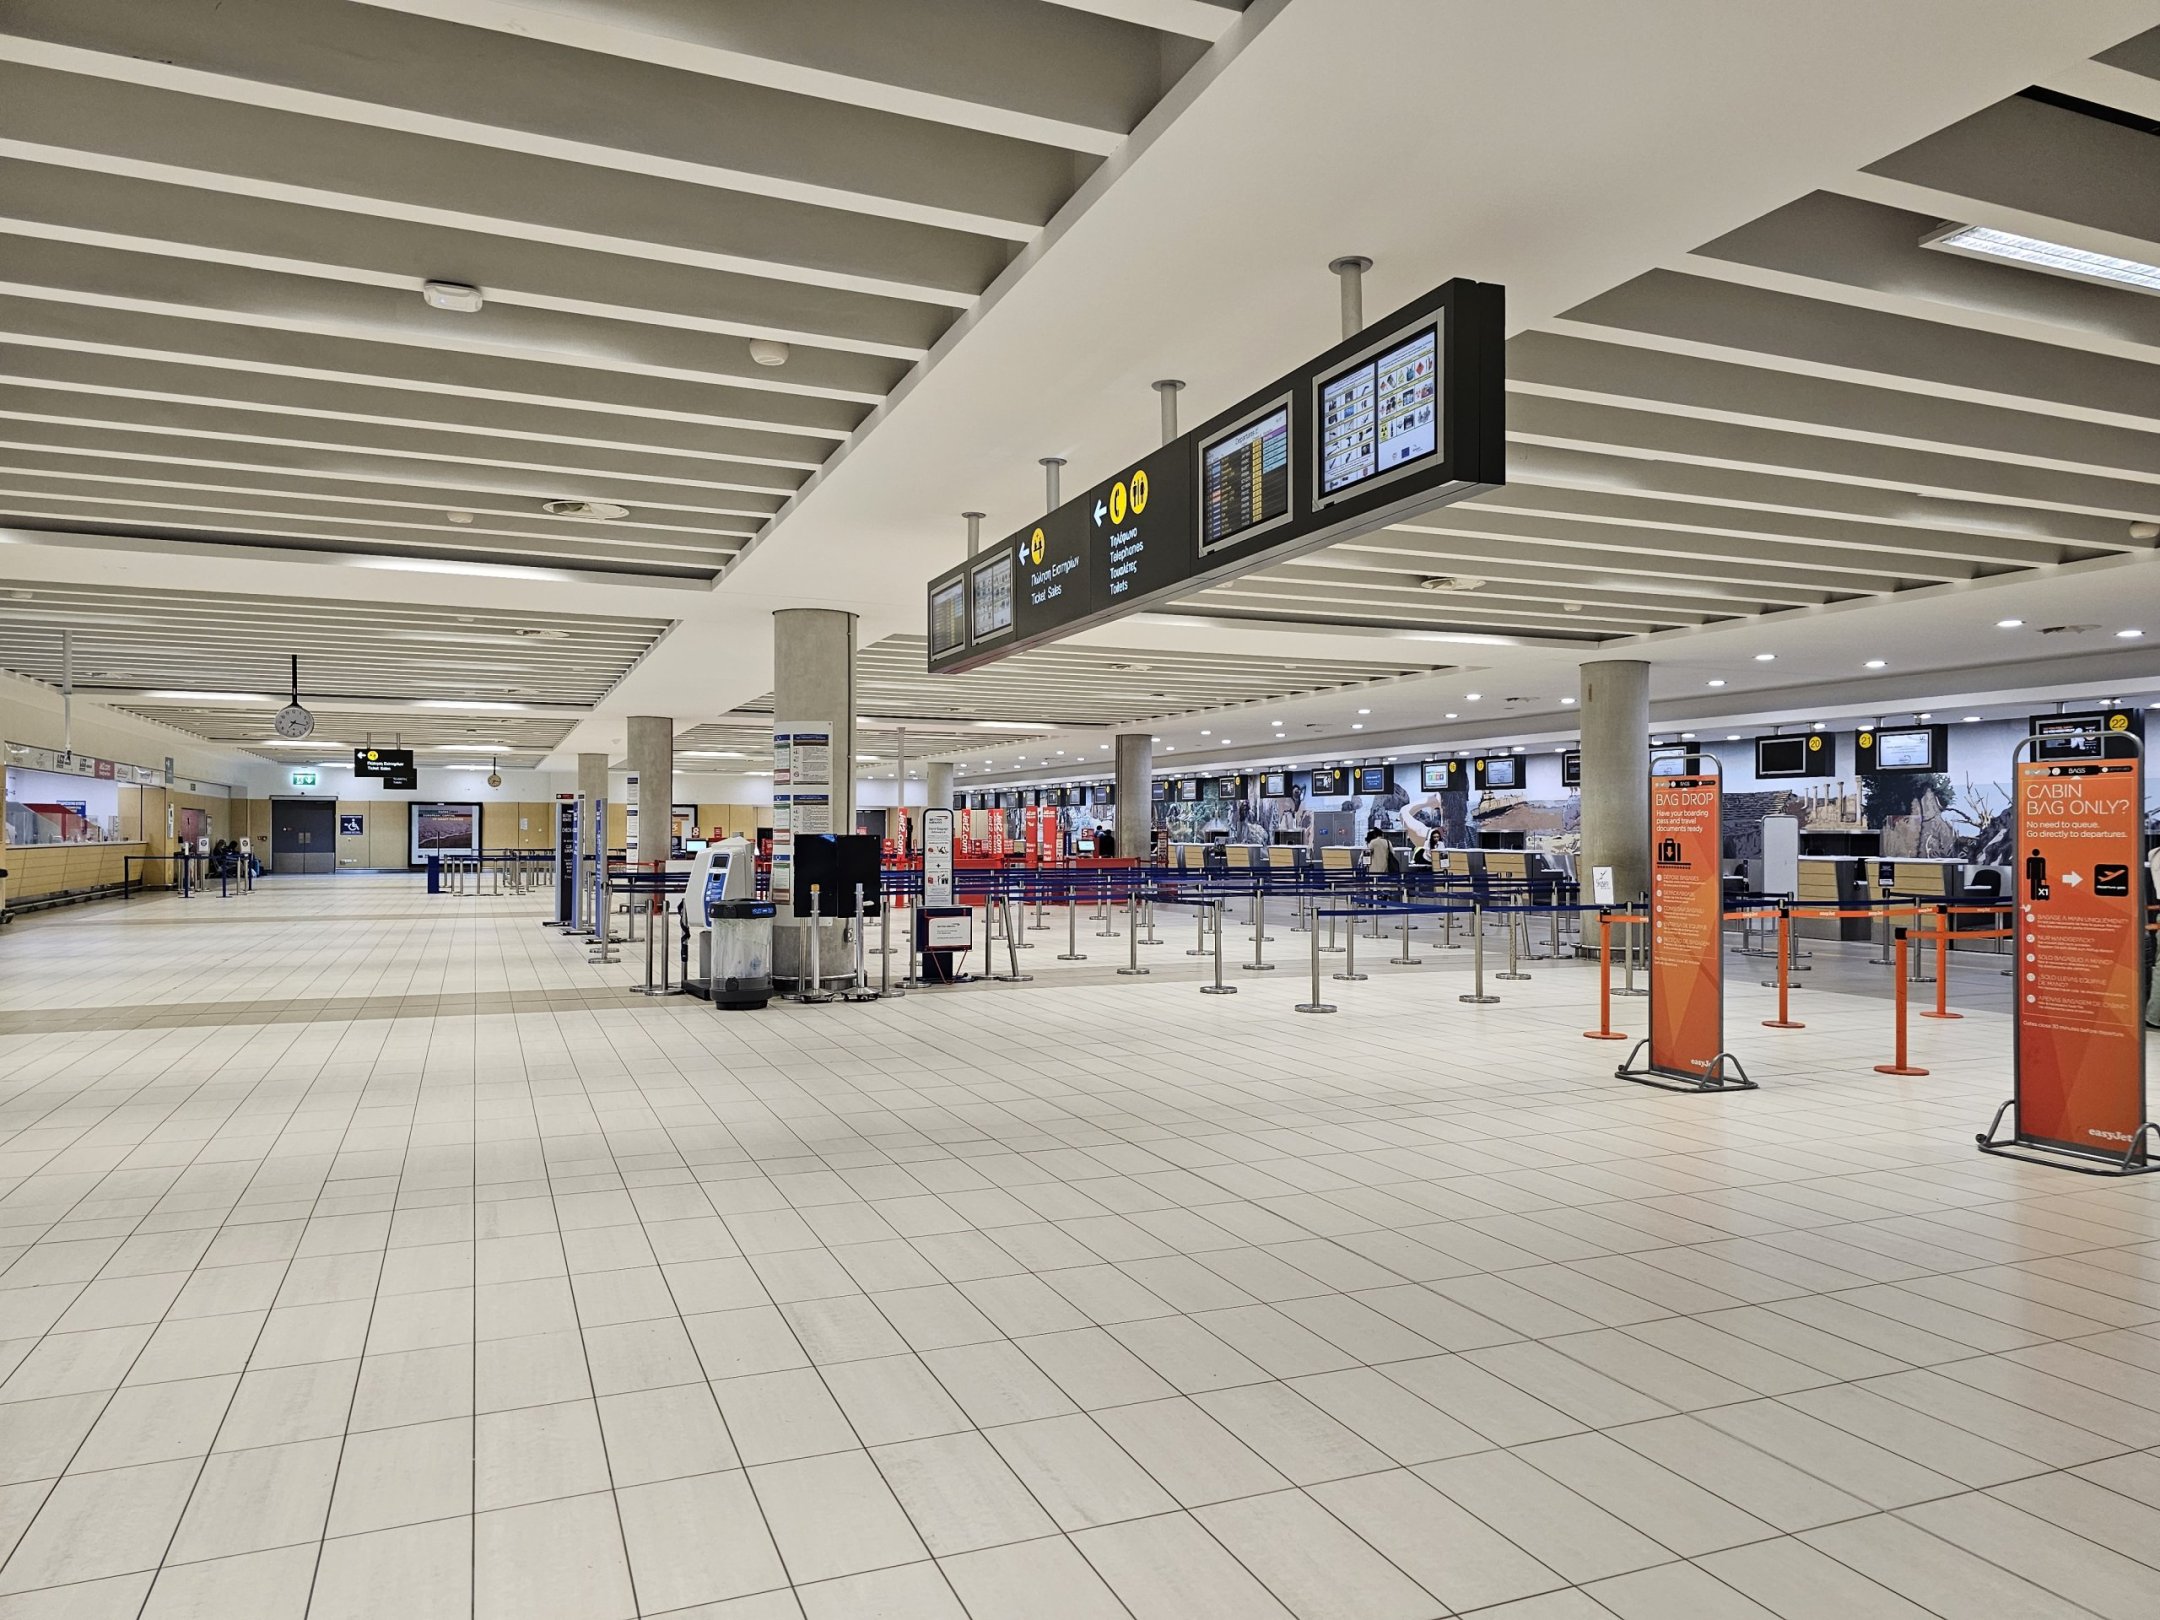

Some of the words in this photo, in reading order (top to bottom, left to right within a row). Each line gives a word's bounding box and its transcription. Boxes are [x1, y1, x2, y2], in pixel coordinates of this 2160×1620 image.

[1110, 541, 1144, 564] Telephones
[1110, 560, 1137, 580] Τουαλέτες
[1031, 589, 1046, 605] Ticket
[1047, 584, 1062, 599] Sales
[1110, 580, 1128, 595] Toilets
[2111, 718, 2126, 728] 22
[1810, 739, 1820, 748] 20
[1861, 736, 1871, 745] 21
[2026, 784, 2082, 799] CABIN
[1656, 793, 1679, 806] BAG
[1681, 792, 1714, 806] DROP
[1683, 810, 1709, 818] boarding
[2027, 801, 2064, 815] BAG
[2069, 799, 2130, 815] ONLY?
[693, 828, 699, 836] 8
[897, 811, 906, 854] Jet2.com
[961, 812, 970, 853] Jet2.com
[1687, 825, 1703, 833] ready
[2026, 830, 2038, 838] Go
[2039, 830, 2068, 838] directly
[2080, 831, 2128, 839] departures.
[2038, 888, 2049, 896] X1
[2088, 1128, 2134, 1143] easyJet
